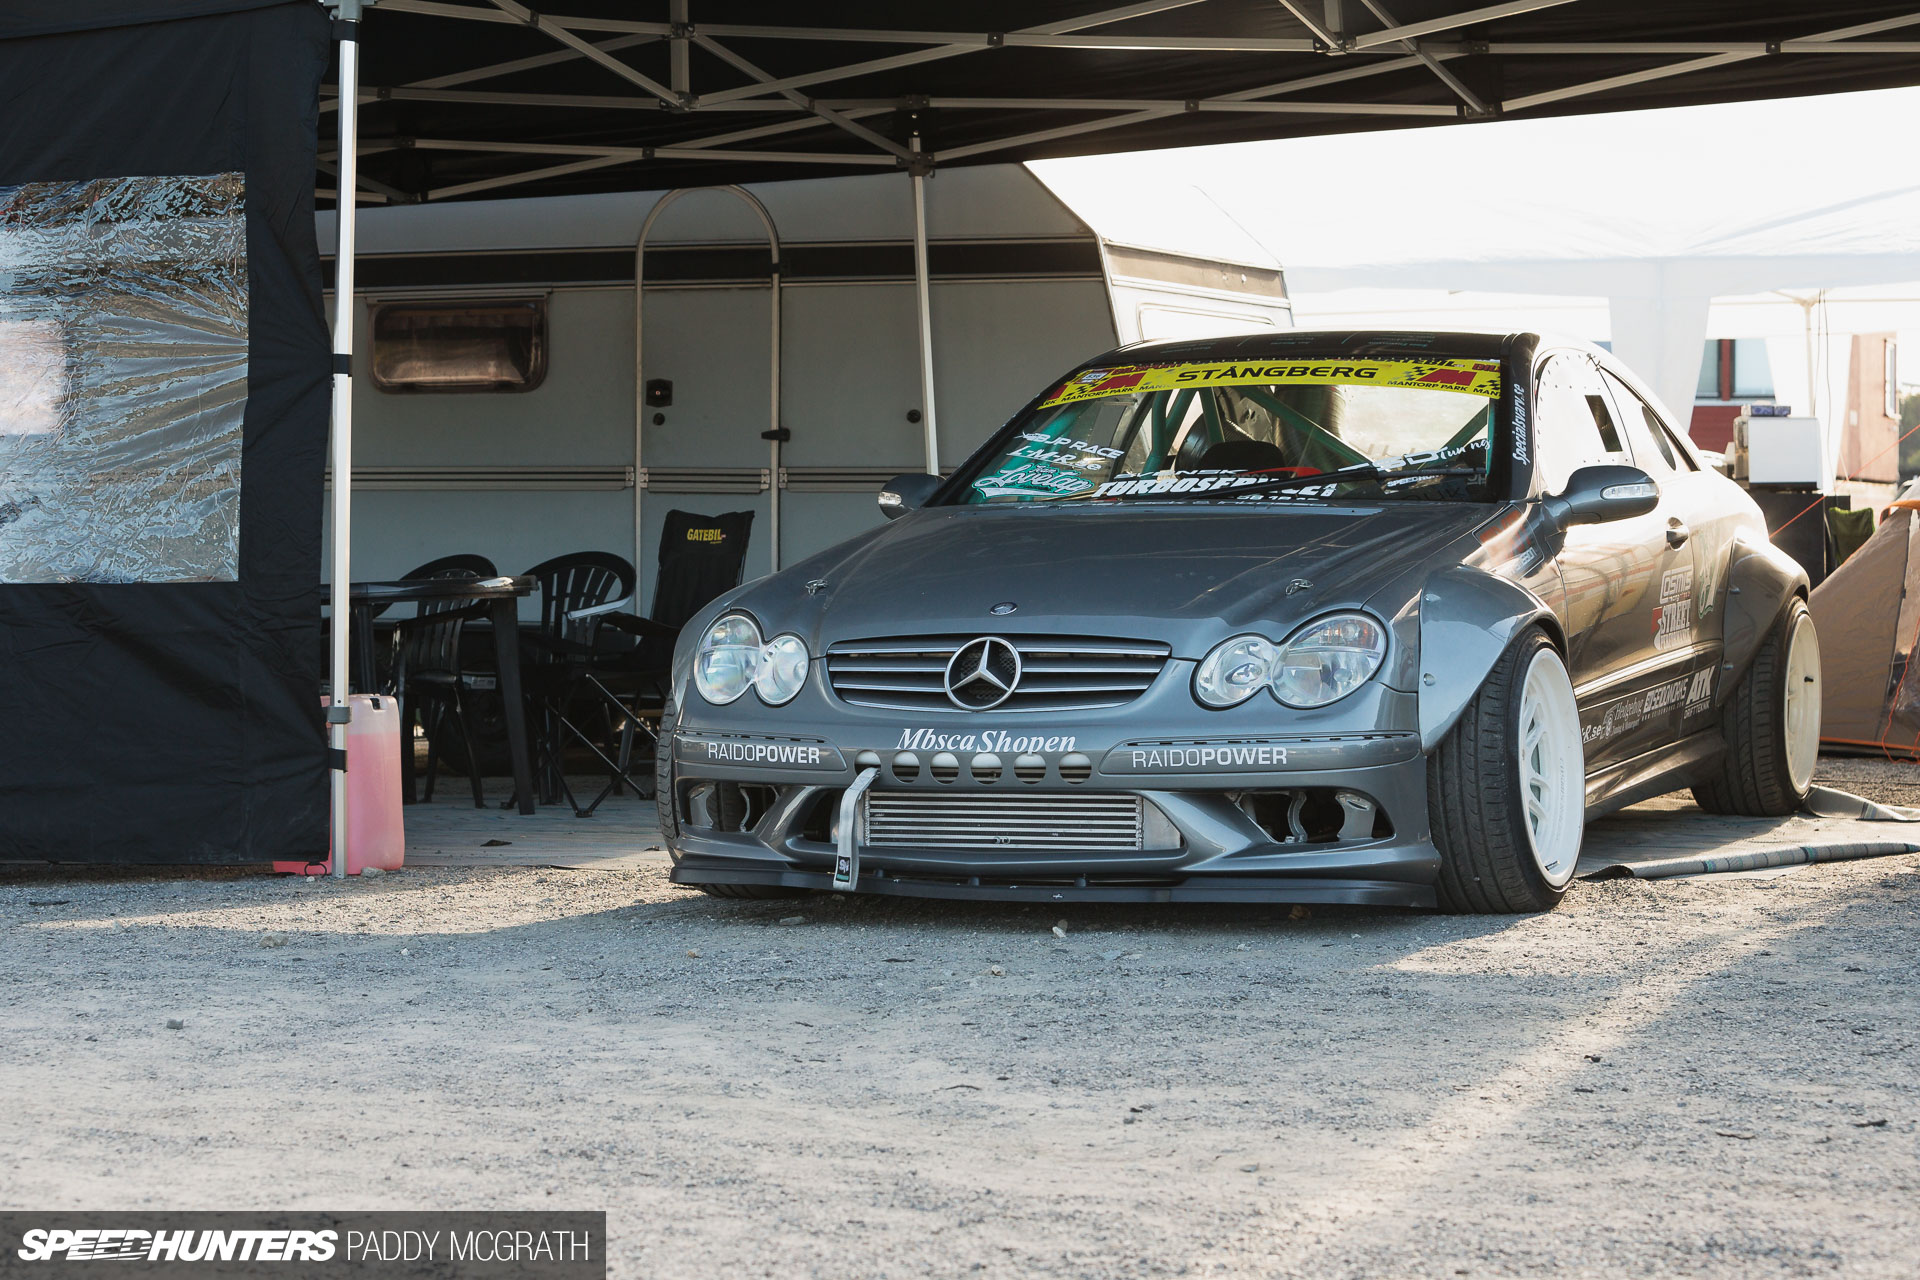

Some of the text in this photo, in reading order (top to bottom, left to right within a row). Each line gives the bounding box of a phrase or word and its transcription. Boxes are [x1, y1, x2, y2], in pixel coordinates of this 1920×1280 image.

[1176, 366, 1379, 382] STÅNGBERG
[1061, 386, 1135, 402] MANTORP PARK
[1387, 380, 1468, 392] MANTORP PARK
[1069, 440, 1125, 459] RACE
[687, 528, 723, 542] GATEBIL
[1660, 599, 1691, 635] STREET
[1685, 665, 1716, 706] ATK
[895, 728, 1076, 755] Mbsca Shopen
[708, 742, 820, 764] RAIDOPOWER
[1132, 747, 1287, 767] RAIDOPOWER
